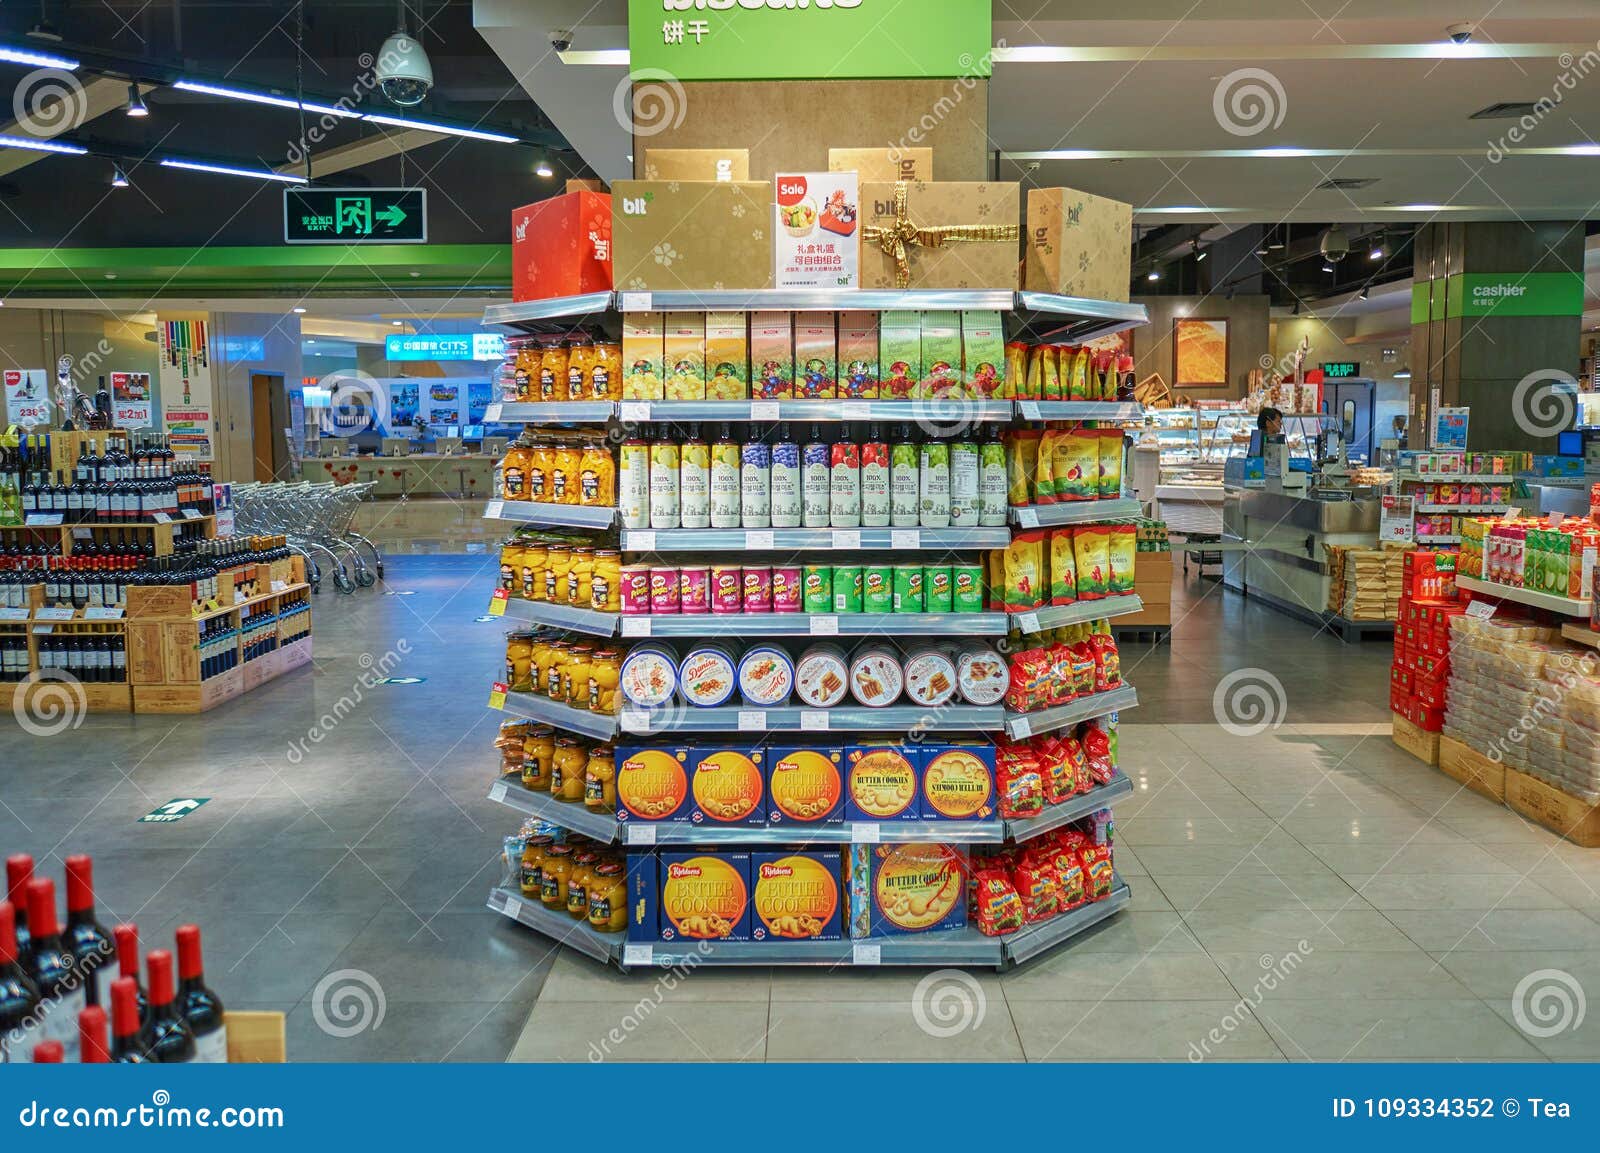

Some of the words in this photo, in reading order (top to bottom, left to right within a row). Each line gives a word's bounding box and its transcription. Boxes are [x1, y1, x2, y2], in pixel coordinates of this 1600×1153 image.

[662, 19, 709, 44] 饼干
[780, 184, 805, 195] Sale
[623, 197, 648, 216] blt
[794, 255, 843, 266] 可自由组合
[1472, 284, 1527, 297] cashier
[439, 341, 469, 352] CITS
[687, 659, 718, 682] Danisa
[857, 776, 882, 784] BUTTER
[882, 776, 909, 784] COOKIES
[672, 865, 701, 878] Kjeldsens
[764, 865, 793, 877] Kjeldsens
[885, 874, 918, 888] BUTTER
[676, 880, 734, 897] BUTTER
[767, 880, 825, 897] BUTTER
[670, 897, 739, 913] COOKIES
[761, 897, 831, 913] COOKIES
